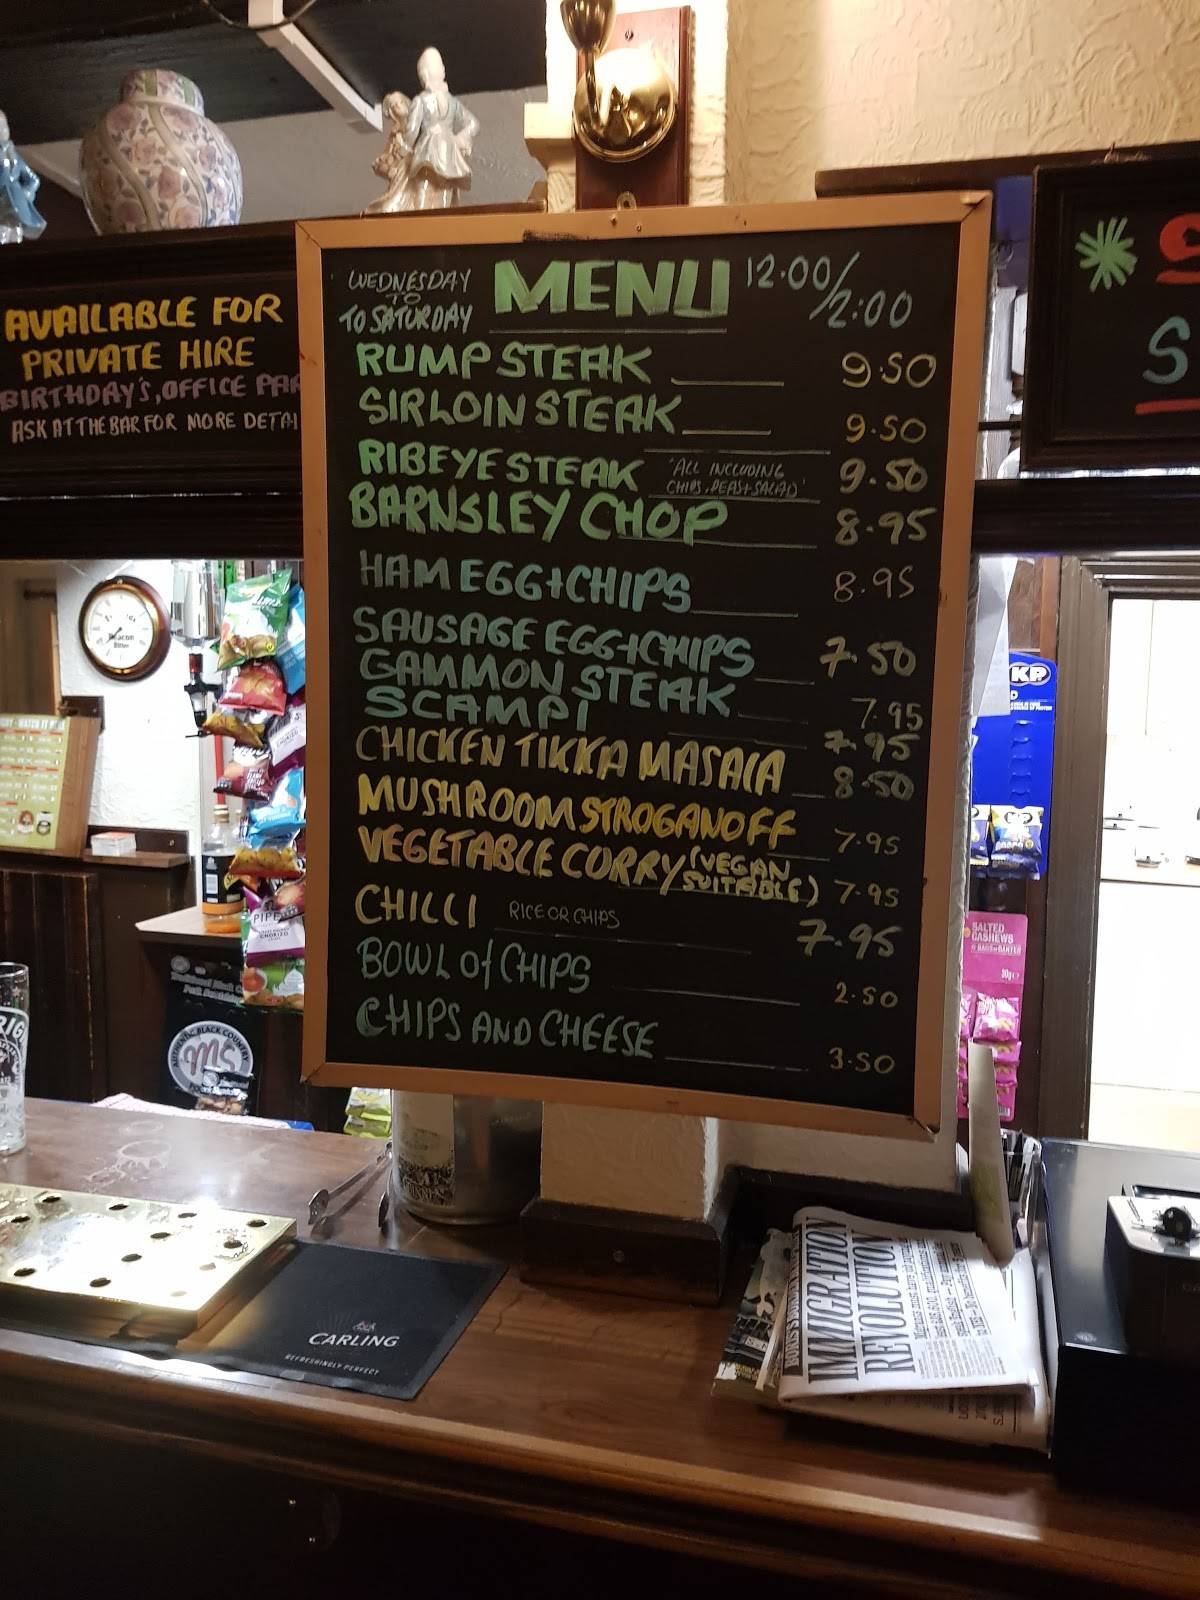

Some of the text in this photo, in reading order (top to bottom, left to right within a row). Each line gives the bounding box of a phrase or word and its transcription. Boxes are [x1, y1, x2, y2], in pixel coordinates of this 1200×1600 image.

[348, 268, 471, 293] WEDNESDAY
[494, 258, 730, 318] MENU
[5, 293, 284, 342] AVAILABLE FOR
[339, 302, 473, 334] TO SATURDAY
[21, 335, 255, 381] PRIVATE HIRE
[356, 341, 937, 388] RUMP STEAK 9.50
[162, 374, 247, 400] OFFICE
[12, 418, 47, 444] ASK
[53, 418, 73, 439] AT
[74, 415, 107, 437] THE
[109, 415, 141, 435] BAR
[144, 412, 178, 434] FOR
[187, 411, 236, 432] MORE
[359, 386, 926, 443] SIRLOIN STEAK 9.50
[358, 438, 928, 494] RIBEYE STEAK 9.50
[709, 462, 784, 479] INCLUDING
[349, 482, 937, 547] BARNSLEY CHOP 8.95
[360, 549, 450, 591] HAM
[834, 565, 915, 602] 8.95
[353, 606, 538, 651] SAUSAGE
[820, 636, 917, 677] 7.50
[360, 648, 924, 730] GAMMON STEAK 7.95
[1011, 666, 1047, 682] KP
[364, 685, 920, 763] SCAMPI 7.95
[356, 726, 915, 801] CHICKEN TIKKA MASALA 8.50
[358, 773, 900, 855] MUSHROOM STROGANOFF 7.95
[359, 824, 790, 896] VEGETABLE CURRY (VEGAN
[834, 879, 900, 908] 7.95
[355, 884, 902, 960] CHILLI RICE OR CHIPS 7.95
[972, 931, 1014, 945] CASHEWS
[357, 936, 450, 980] BOWL
[501, 943, 591, 994] CHIPS
[834, 982, 898, 1008] 2.50
[197, 1025, 221, 1034] BLACK
[222, 1029, 249, 1062] COUNTRY
[356, 995, 895, 1075] CHIPS AND CHEESE 3.50
[805, 1217, 859, 1384] IMMIGRATION
[851, 1231, 916, 1375] REVOLUTION
[308, 1333, 400, 1347] CARLING
[343, 1364, 380, 1376] PERFECT
